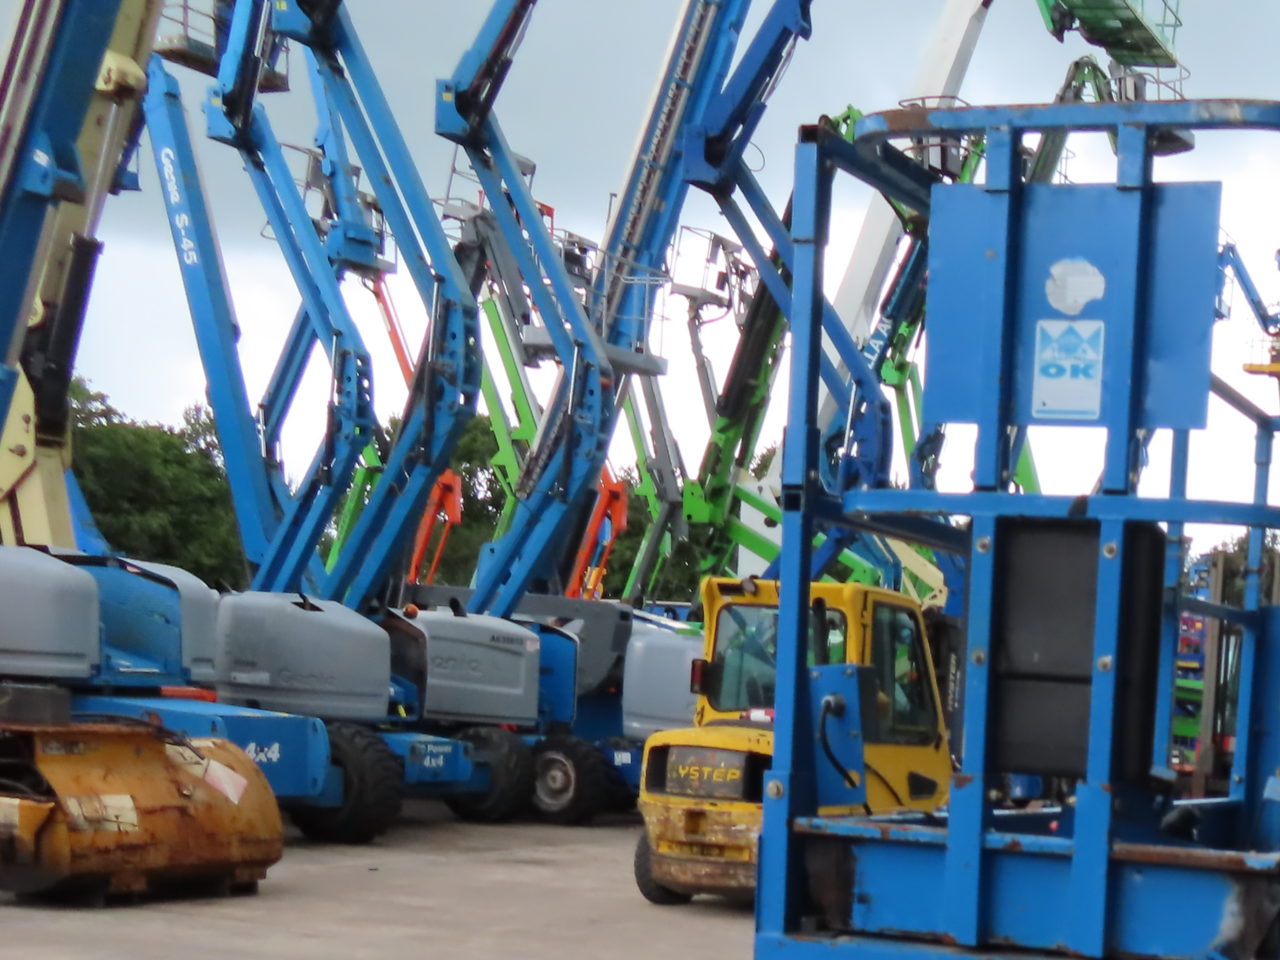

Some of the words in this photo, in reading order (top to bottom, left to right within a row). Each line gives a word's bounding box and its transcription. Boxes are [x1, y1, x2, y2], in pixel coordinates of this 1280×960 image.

[175, 213, 198, 265] S-45
[1039, 363, 1096, 379] OK
[245, 742, 280, 762] 4x4
